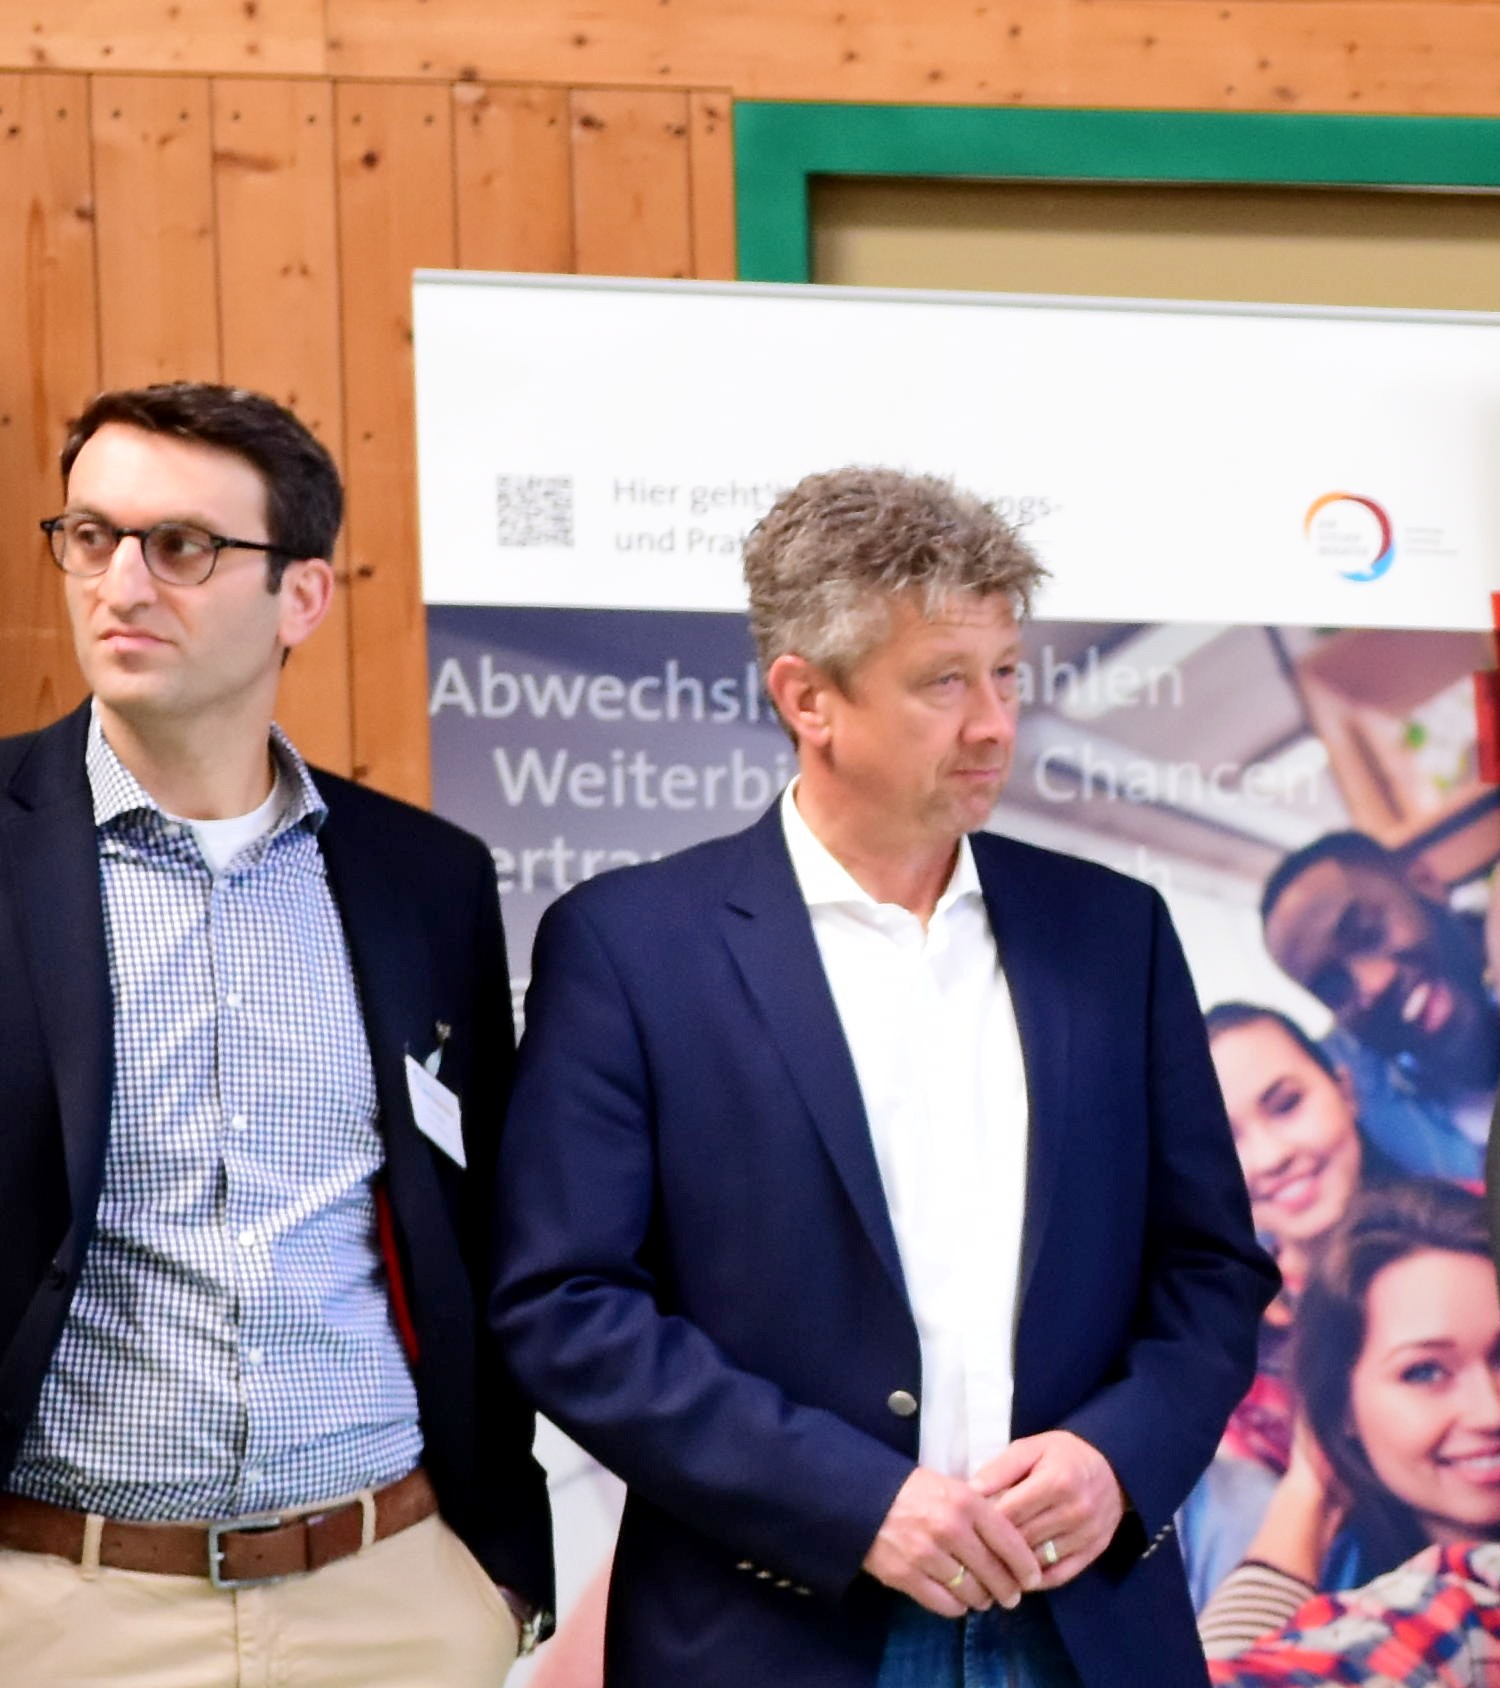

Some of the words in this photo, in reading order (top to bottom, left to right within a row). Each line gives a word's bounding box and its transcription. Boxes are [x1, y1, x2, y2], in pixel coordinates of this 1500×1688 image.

[612, 477, 680, 505] Hier
[614, 526, 676, 555] und
[429, 655, 777, 724] Abwechsl
[1015, 644, 1185, 706] ahlen
[493, 747, 788, 812] Weiterbi
[1033, 744, 1321, 804] Chancen
